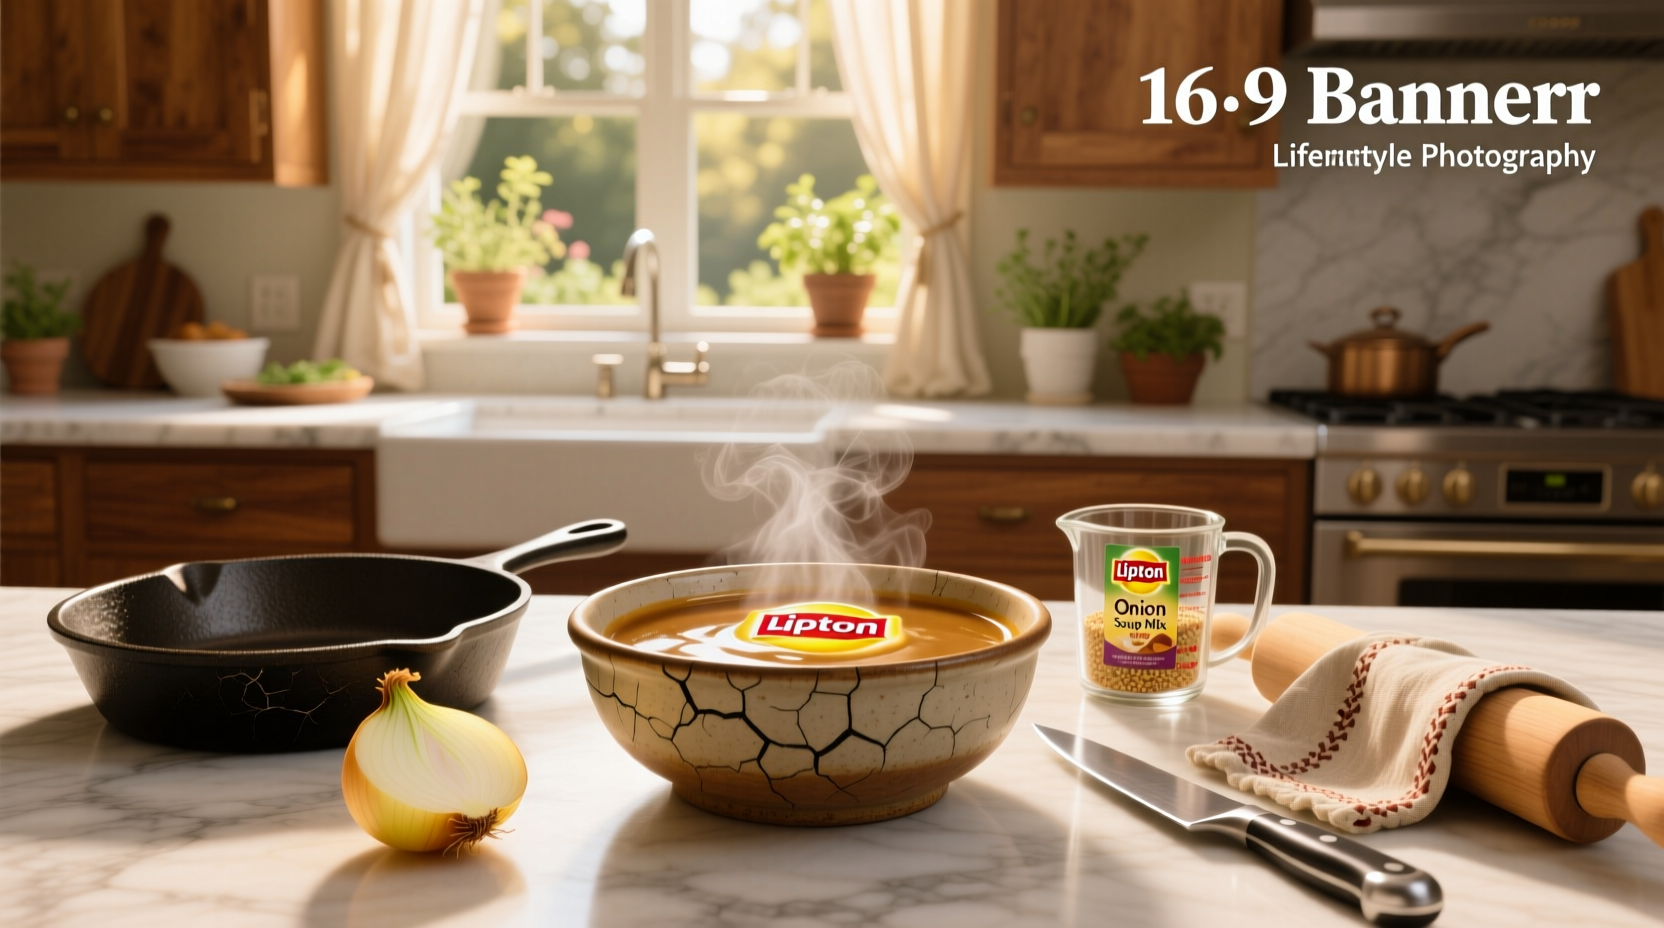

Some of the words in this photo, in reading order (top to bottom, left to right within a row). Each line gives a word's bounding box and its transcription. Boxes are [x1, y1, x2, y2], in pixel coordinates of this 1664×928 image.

[1116, 562, 1164, 581] Lipton
[1114, 598, 1166, 616] Onion
[766, 614, 878, 635] Lipton
